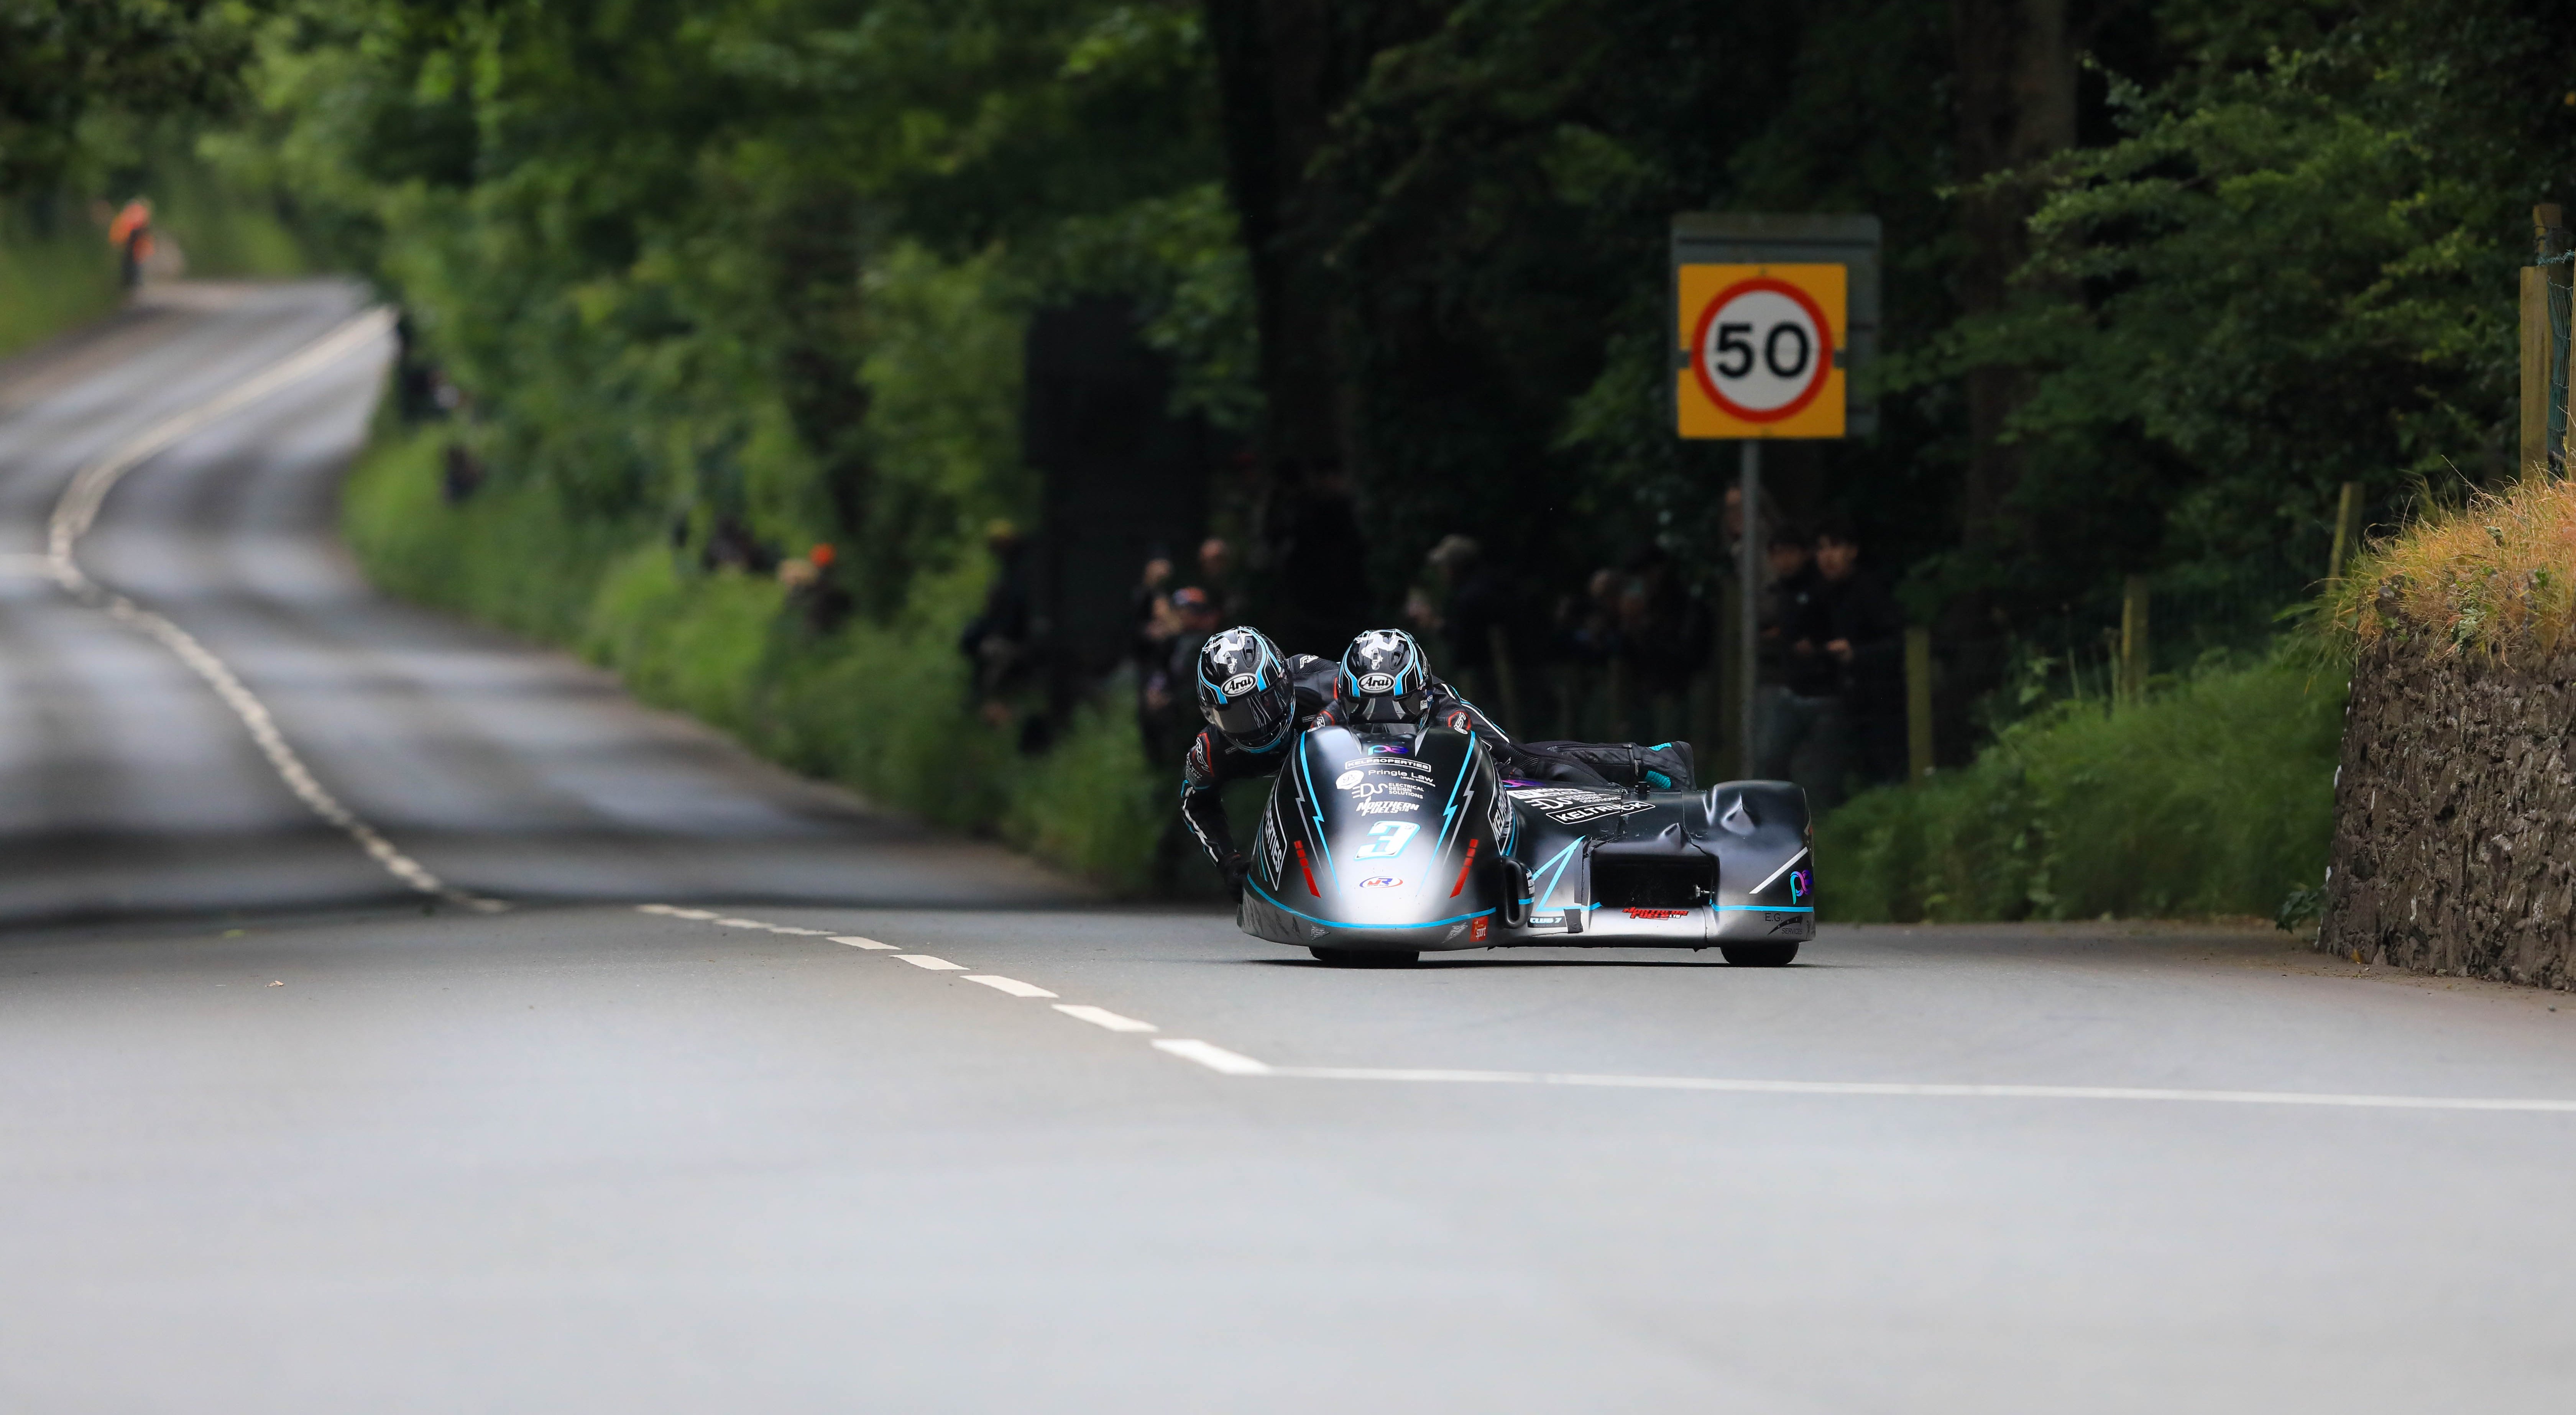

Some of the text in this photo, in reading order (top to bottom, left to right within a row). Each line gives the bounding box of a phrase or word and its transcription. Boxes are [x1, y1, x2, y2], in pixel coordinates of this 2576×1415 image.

[1715, 321, 1810, 379] 50
[1228, 676, 1252, 691] Arai
[1362, 676, 1390, 686] Arai
[1348, 758, 1429, 770] KELPROPERTIES
[1411, 772, 1433, 782] Law
[1416, 778, 1436, 787] SERVICES
[1388, 783, 1424, 792] ELECTRICAL
[1389, 790, 1423, 799] SOLUTIONS
[1356, 796, 1419, 811] NORTHERN
[1361, 807, 1399, 816] FUELS
[1556, 802, 1649, 821] KELTRUCK
[1353, 821, 1421, 861] 3
